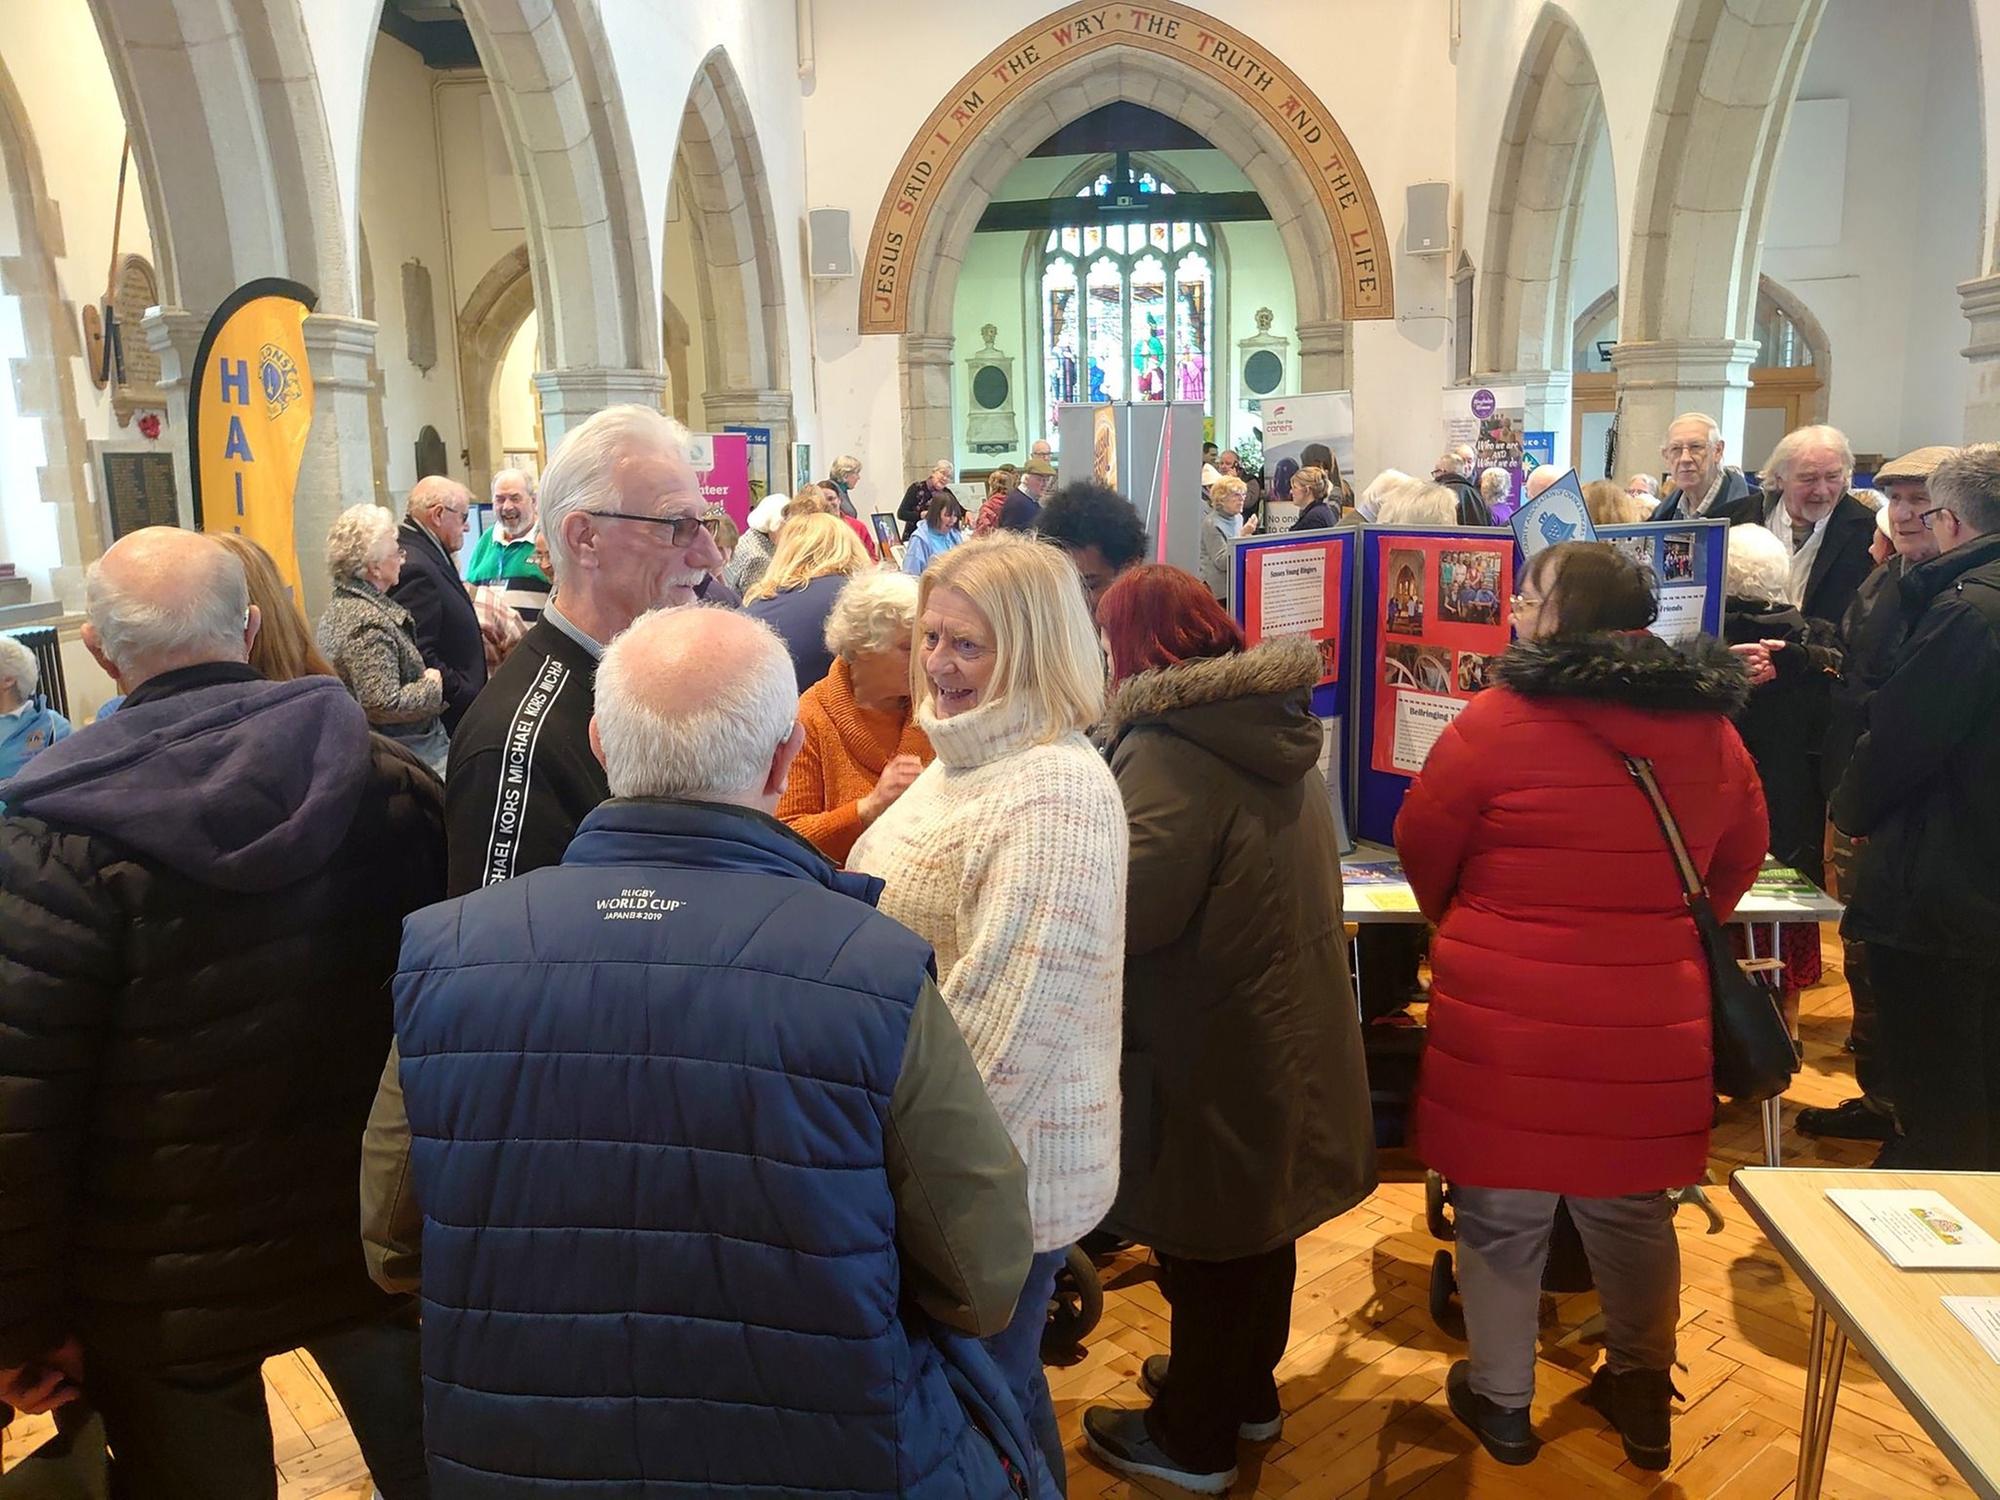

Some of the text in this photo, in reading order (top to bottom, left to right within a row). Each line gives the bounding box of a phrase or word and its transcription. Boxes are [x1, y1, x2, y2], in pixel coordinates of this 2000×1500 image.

[876, 9, 1378, 314] JESUS SAID I AM THE WAY THE TRUTH AND THE LIFE
[1266, 424, 1293, 432] carers
[220, 357, 254, 535] HAI
[1268, 515, 1281, 523] No
[524, 692, 546, 718] KORS
[1409, 707, 1448, 722] Bellringing
[508, 721, 534, 784] MICHAEL
[500, 789, 520, 835] KORS
[621, 889, 656, 898] RUGBY
[596, 898, 648, 910] WORLD
